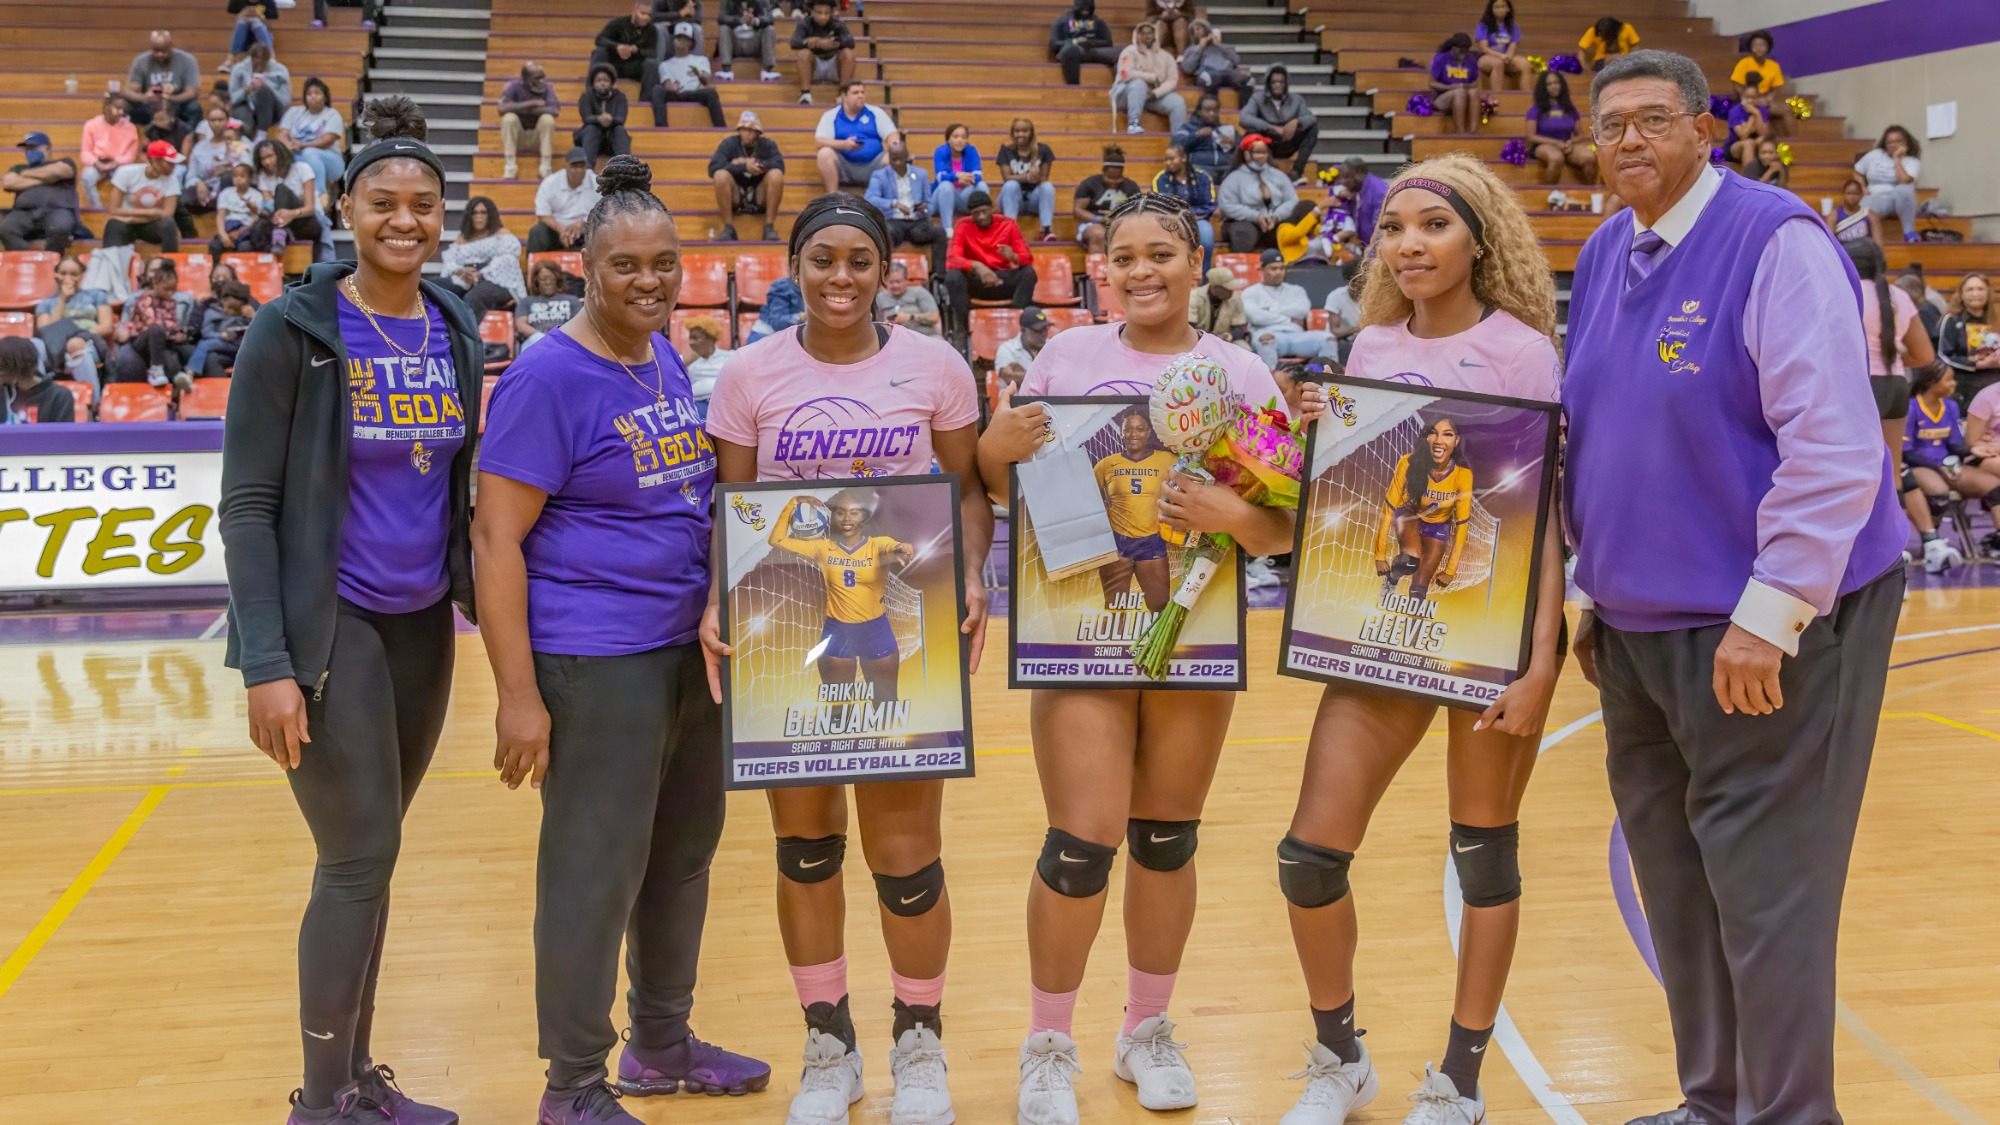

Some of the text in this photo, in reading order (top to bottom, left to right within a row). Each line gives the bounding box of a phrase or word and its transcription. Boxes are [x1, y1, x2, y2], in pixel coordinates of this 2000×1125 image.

[1407, 179, 1452, 197] BEAUTY
[385, 429, 417, 439] BENEDICT
[418, 429, 444, 438] COLLEGE
[774, 425, 920, 461] BENEDICT
[1113, 468, 1160, 477] BENEDICT
[1130, 478, 1143, 495] 5
[827, 556, 873, 568] BENEDICT
[842, 569, 856, 588] 8
[1108, 592, 1145, 610] JADE
[1377, 593, 1439, 619] JORDAN
[1359, 611, 1449, 653] REEVES
[1094, 647, 1122, 657] SENIOR
[1350, 645, 1380, 659] SENIOR
[1388, 652, 1422, 667] OUTSIDE
[1424, 659, 1451, 672] HITTER
[1021, 663, 1235, 677] TIGERS VOLLEYLL 2022
[1292, 651, 1505, 701] TIGERS VOLLEYBALL 202
[818, 681, 875, 702] BRIKYIA
[784, 699, 911, 737] BENJAMIN
[791, 742, 821, 753] SENIOR
[830, 740, 855, 751] RIGHT
[858, 739, 877, 749] SIDE
[879, 737, 906, 748] HITTER
[737, 752, 962, 776] TIGERS VOLLEYBALL 2022
